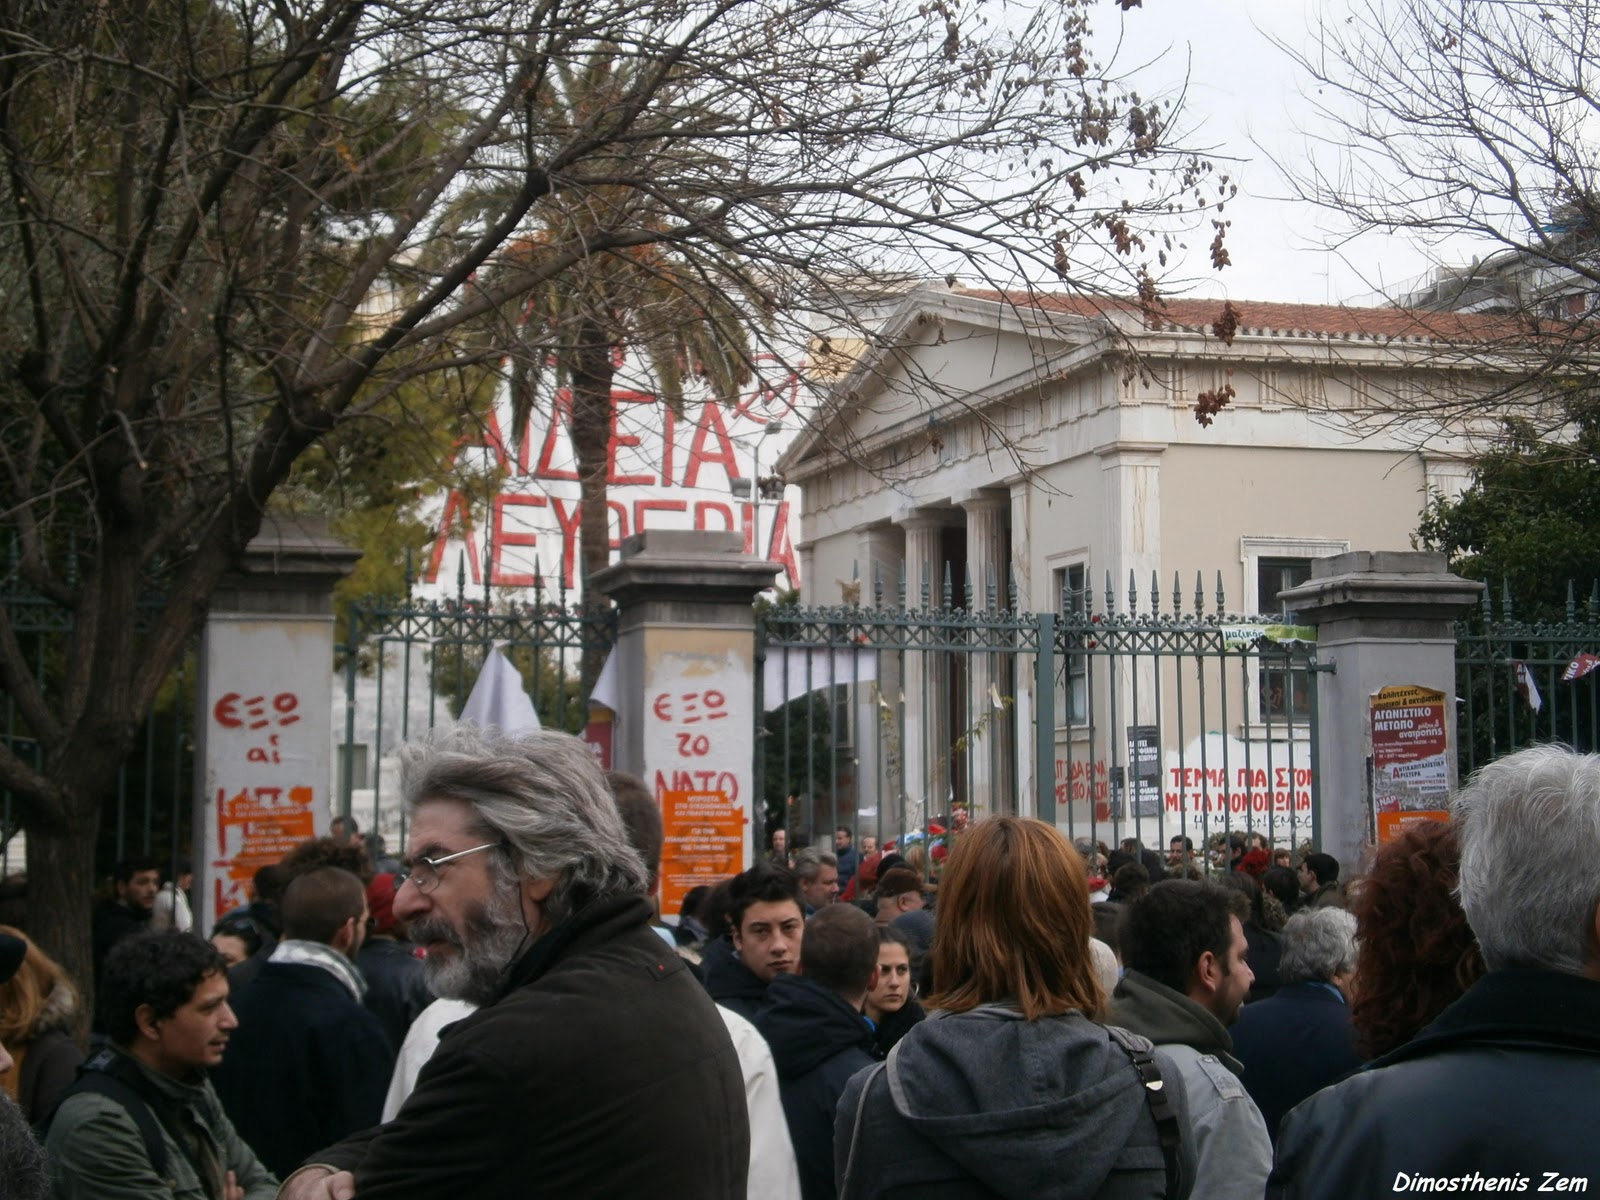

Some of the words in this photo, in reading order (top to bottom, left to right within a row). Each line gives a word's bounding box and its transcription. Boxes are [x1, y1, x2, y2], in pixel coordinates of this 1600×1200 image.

[448, 387, 742, 488] ΑΙΔΕΙΑ
[1374, 707, 1432, 720] ΑΓΩΝΙΣΤΙΚΟ
[1374, 719, 1414, 732] ΜΕΤΩΠΟ
[1399, 727, 1443, 739] ανατροπής
[1170, 768, 1229, 787] ΤΕΡΜΑ
[1238, 768, 1267, 787] ΠΙΑ
[1192, 792, 1212, 811] ΤΑ
